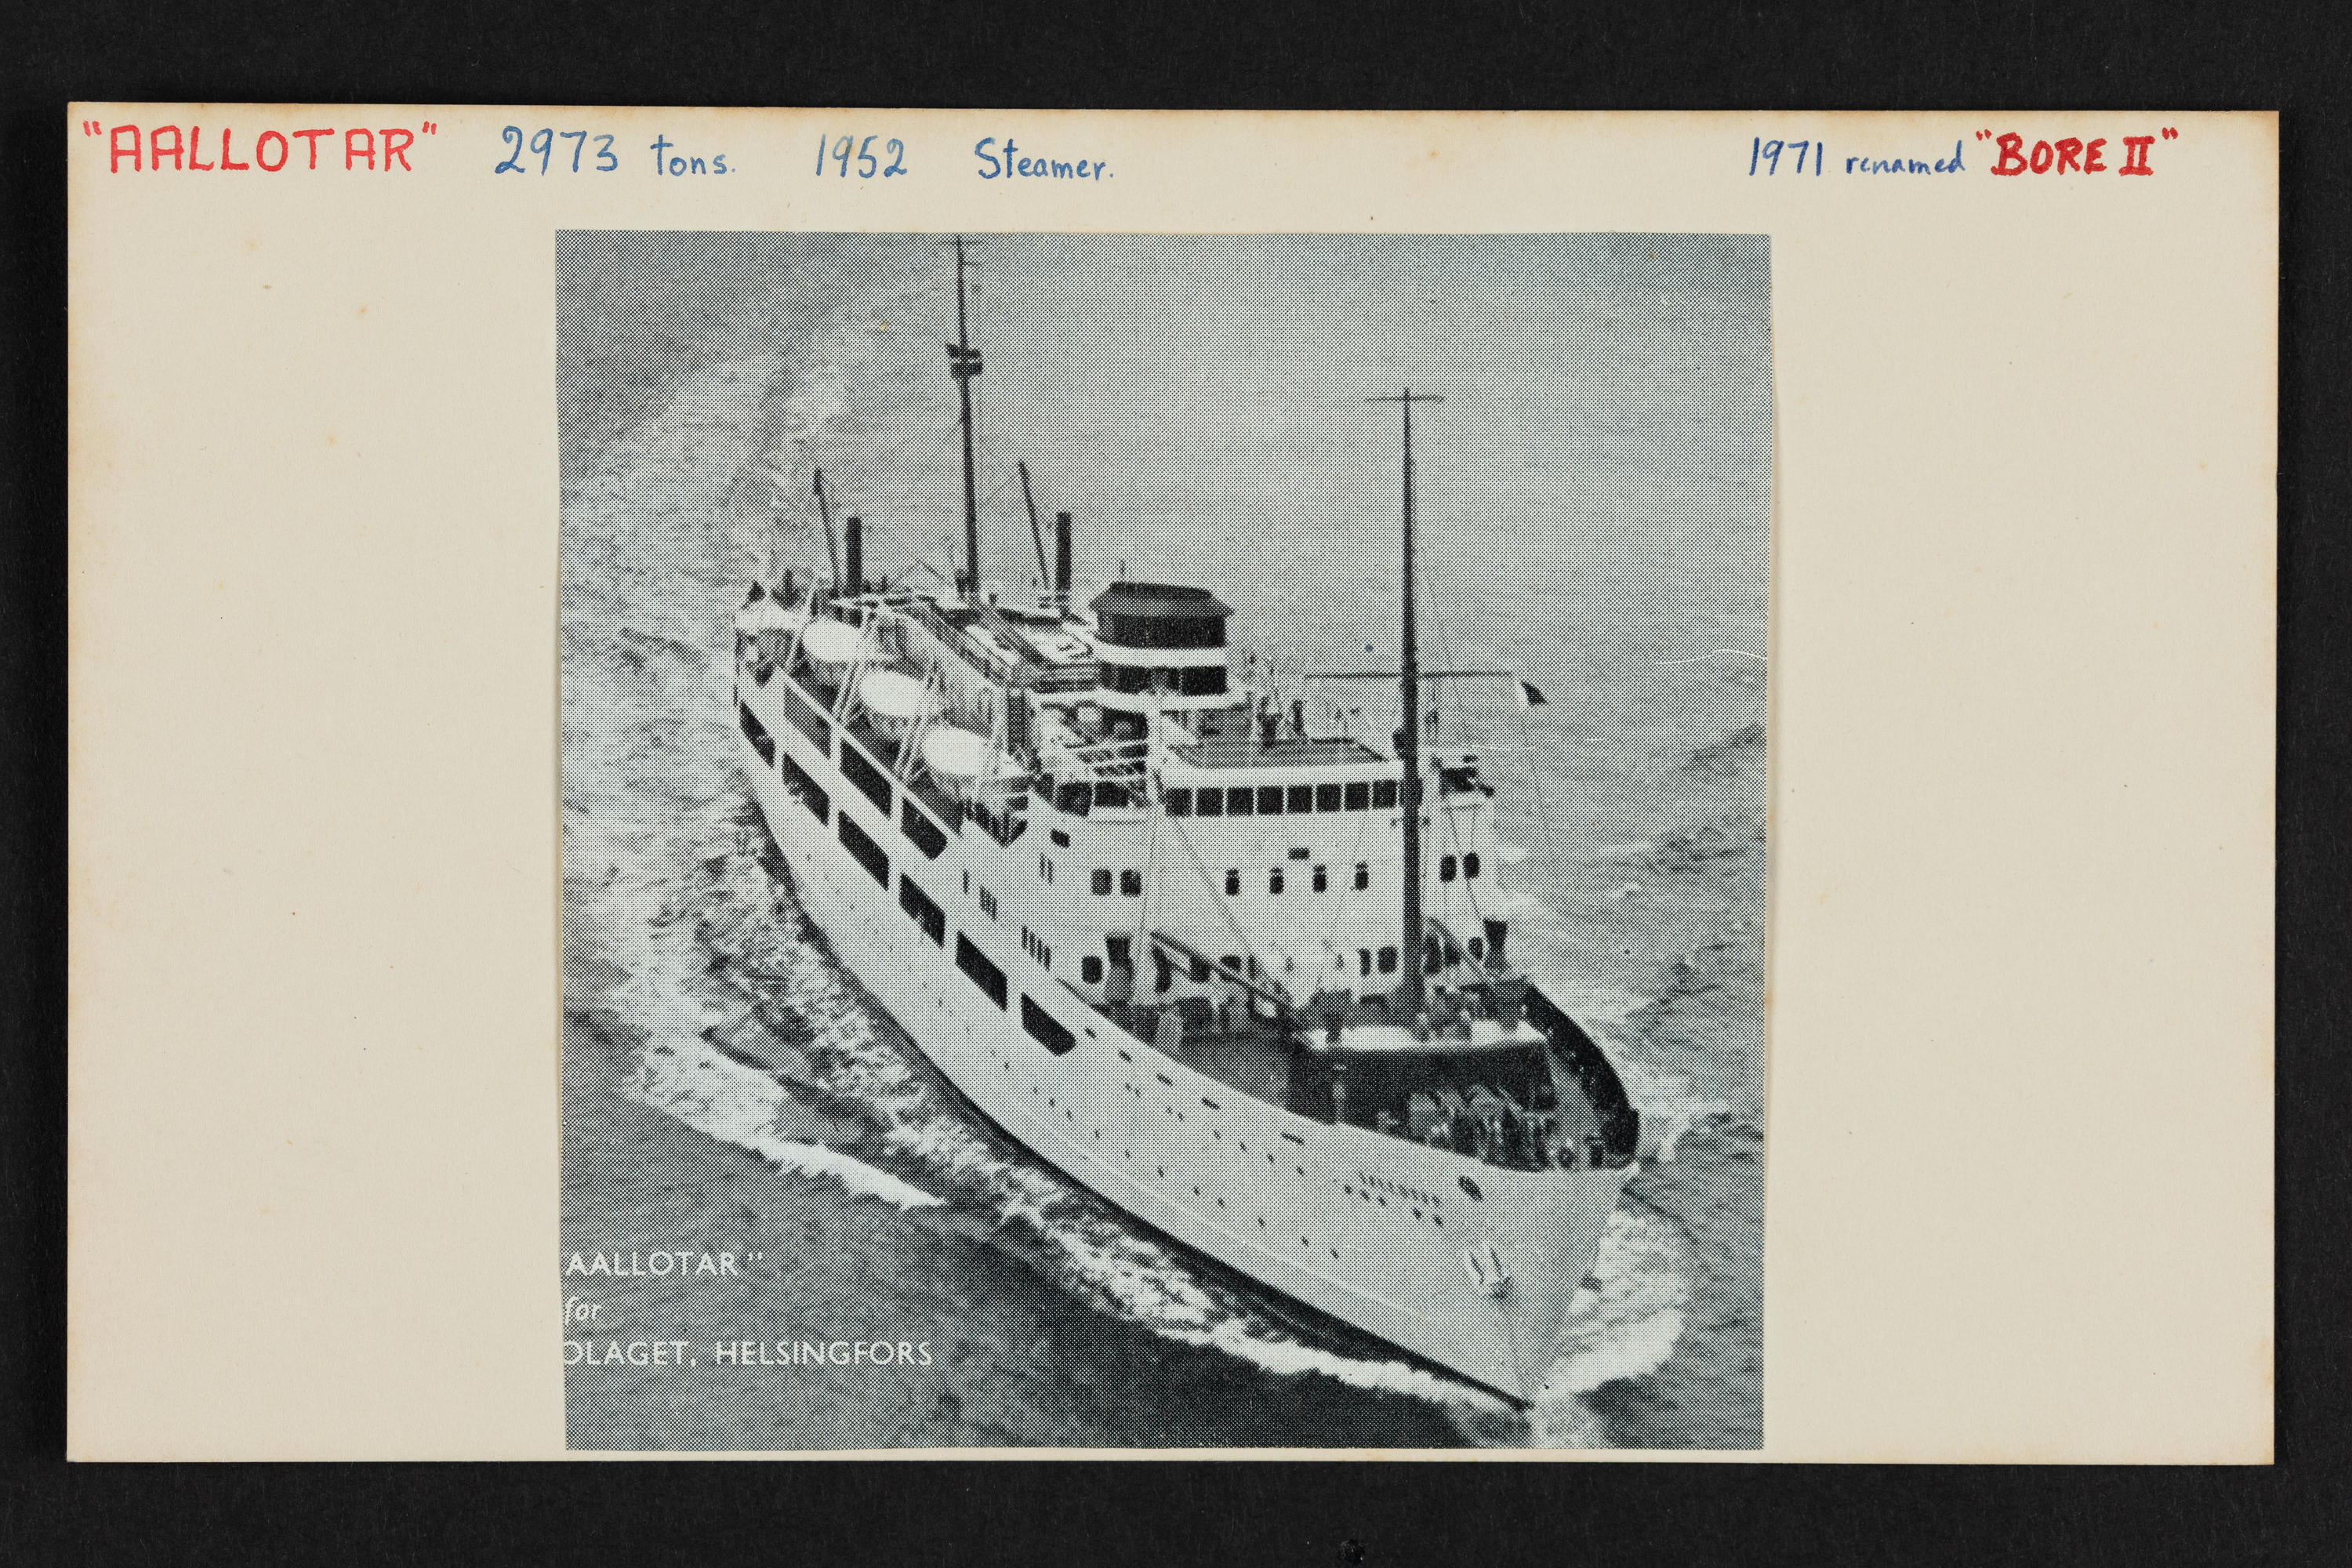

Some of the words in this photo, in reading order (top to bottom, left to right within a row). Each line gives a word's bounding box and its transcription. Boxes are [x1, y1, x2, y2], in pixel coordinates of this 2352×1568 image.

[82, 120, 438, 174] "AALLOTAR"
[494, 125, 619, 176] 2973
[650, 133, 736, 177] tons.
[815, 134, 909, 179] 1952
[974, 136, 1115, 181] Steamer.
[1748, 136, 1824, 177] 1971
[1845, 139, 1966, 176] renamed
[1975, 128, 2108, 177] "BORE
[563, 1294, 603, 1326] for
[714, 1340, 933, 1366] HELSINGFORS
